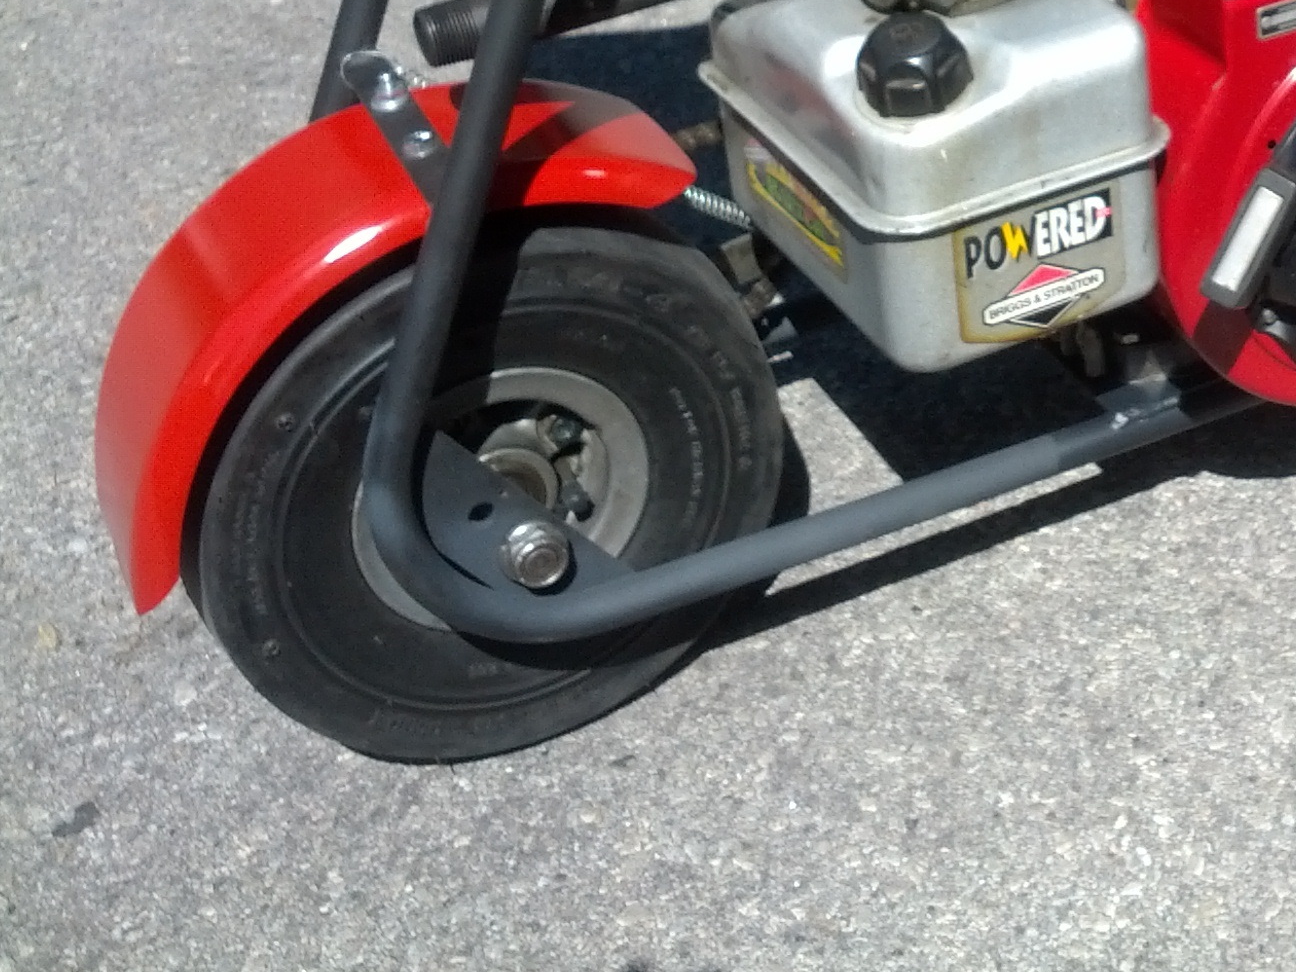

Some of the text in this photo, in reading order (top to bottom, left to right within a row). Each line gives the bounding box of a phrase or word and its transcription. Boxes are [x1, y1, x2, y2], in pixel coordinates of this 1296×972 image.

[964, 196, 1107, 279] POWERED
[989, 273, 1099, 320] BRIGGS & STRATTON
